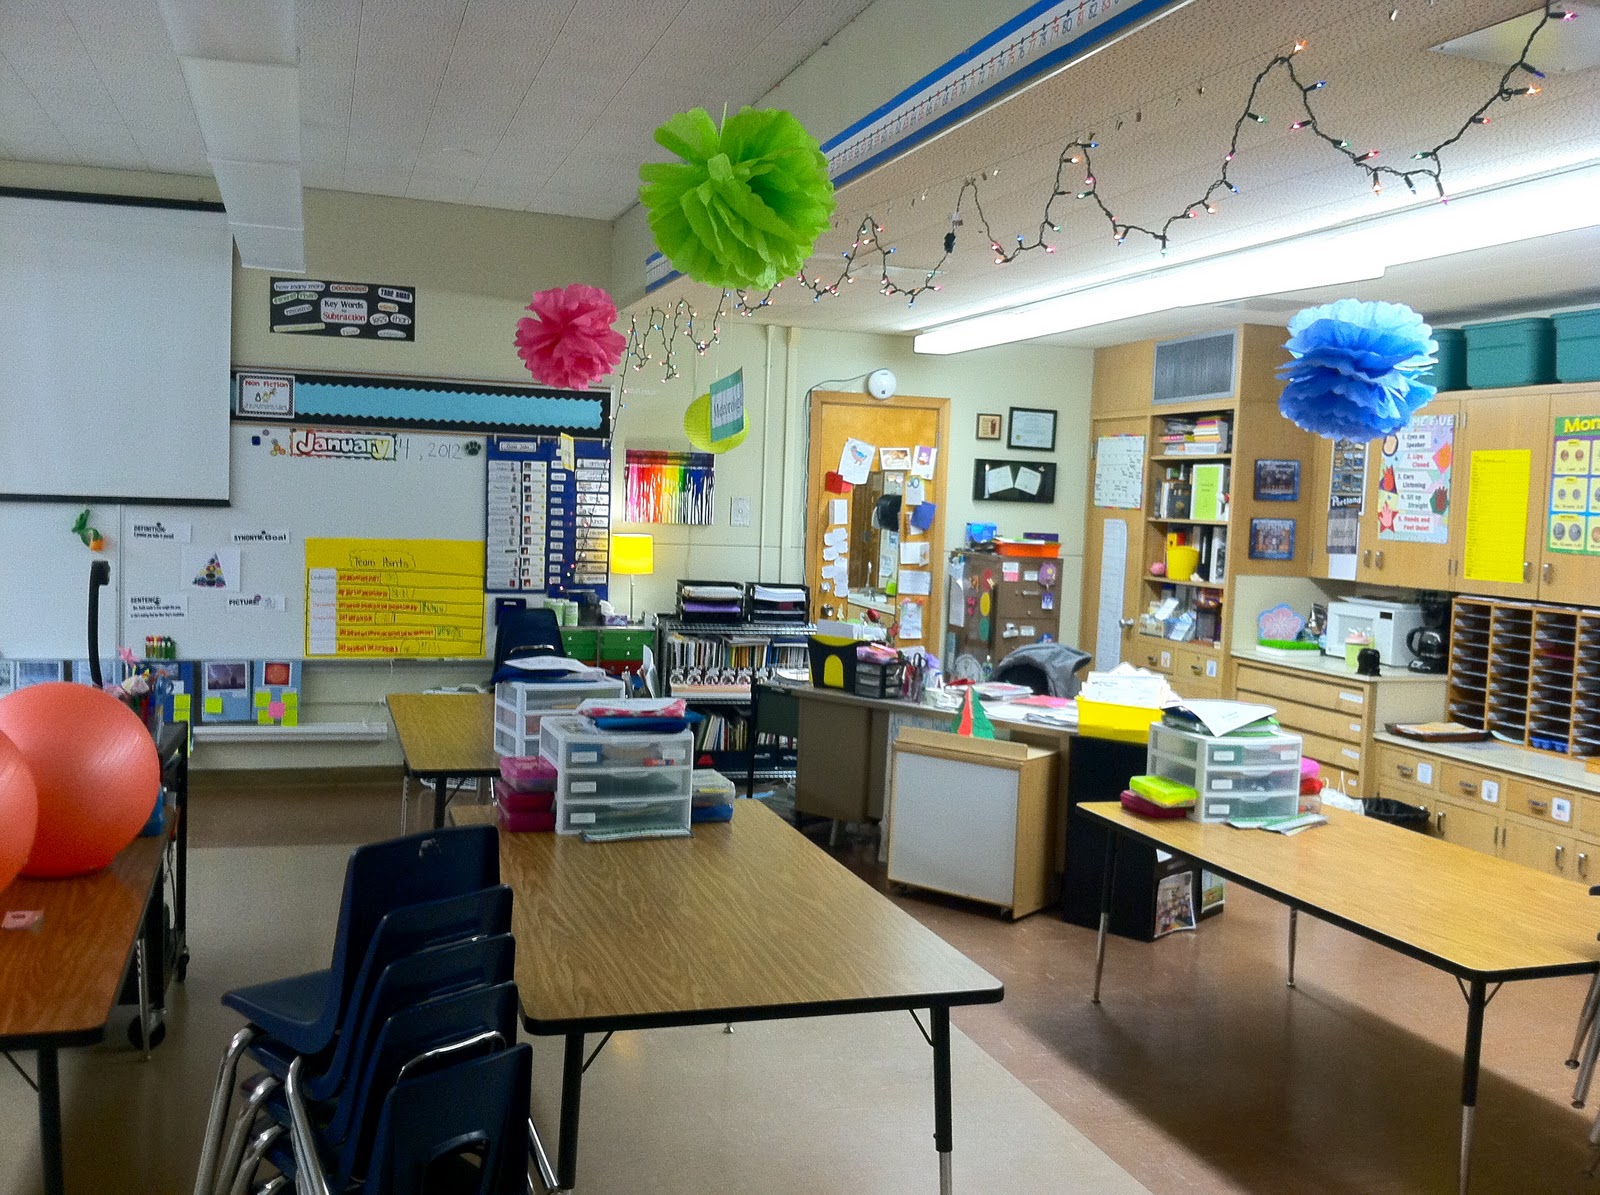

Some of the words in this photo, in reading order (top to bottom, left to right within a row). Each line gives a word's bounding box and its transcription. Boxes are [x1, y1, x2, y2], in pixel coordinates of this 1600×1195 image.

[1061, 16, 1072, 35] 80
[1088, 1, 1097, 20] 82
[324, 300, 338, 309] Key
[341, 301, 363, 309] Words
[322, 312, 366, 321] Subtraction
[1430, 415, 1454, 425] FIVE
[297, 432, 390, 460] January
[428, 442, 462, 460] 2012
[1331, 495, 1361, 506] Portland
